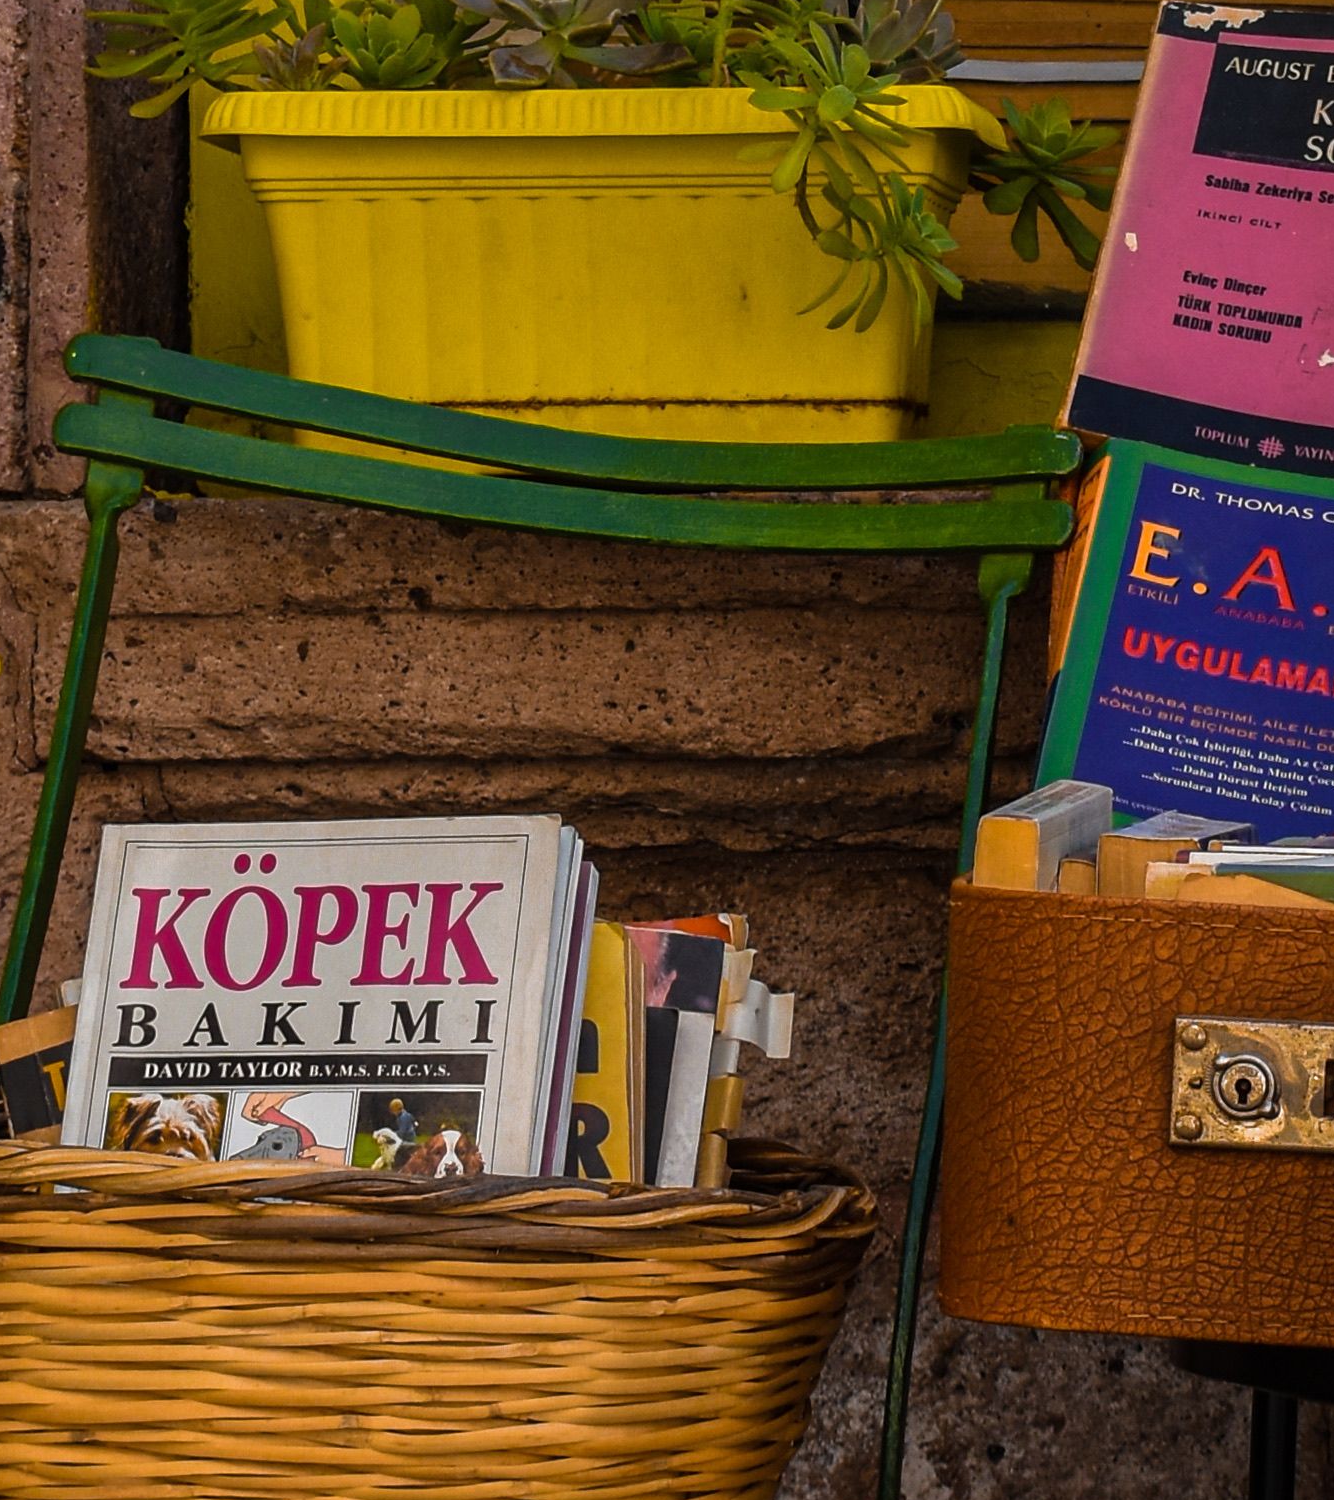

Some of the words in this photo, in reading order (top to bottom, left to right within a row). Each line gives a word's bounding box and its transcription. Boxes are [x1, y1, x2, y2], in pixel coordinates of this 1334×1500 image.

[1224, 56, 1316, 82] AUGUST
[1204, 174, 1251, 195] Sabiha
[1256, 180, 1313, 204] Zekeriya
[1183, 270, 1219, 290] Evinç
[1222, 276, 1267, 298] Dinçer
[1177, 293, 1214, 313] TÜRK
[1216, 301, 1303, 330] TOPLUMUNDA
[1172, 314, 1214, 334] KADIN
[1217, 323, 1272, 344] SORUNU
[1193, 424, 1250, 450] TOPLUM
[1171, 482, 1205, 501] DR.
[1215, 492, 1314, 521] THOMAS
[1127, 583, 1179, 606] ETKİLİ
[1214, 604, 1305, 630] ANABABA
[1111, 685, 1187, 710] ANABABA
[1098, 695, 1152, 718] KÖKLÜ
[1157, 709, 1184, 723] BİR
[1263, 731, 1312, 750] NASIL
[1175, 731, 1199, 748] Çok
[1258, 750, 1289, 764] Daha
[1293, 755, 1309, 768] Az
[1217, 770, 1259, 788] Dürüst
[1262, 777, 1308, 798] İletişim
[1233, 759, 1264, 775] Daha
[1268, 768, 1305, 783] Mutlu
[1216, 787, 1248, 804] Daha
[1251, 793, 1286, 811] Kolay
[1290, 799, 1333, 818] Çözüm
[119, 853, 505, 992] KÖPEK
[112, 1000, 498, 1047] BAKIMI
[144, 1062, 211, 1079] DAVID
[217, 1060, 303, 1079] TAYLOR
[309, 1064, 371, 1078] B.V.M.S.
[376, 1063, 451, 1078] F.R.C.V.S.
